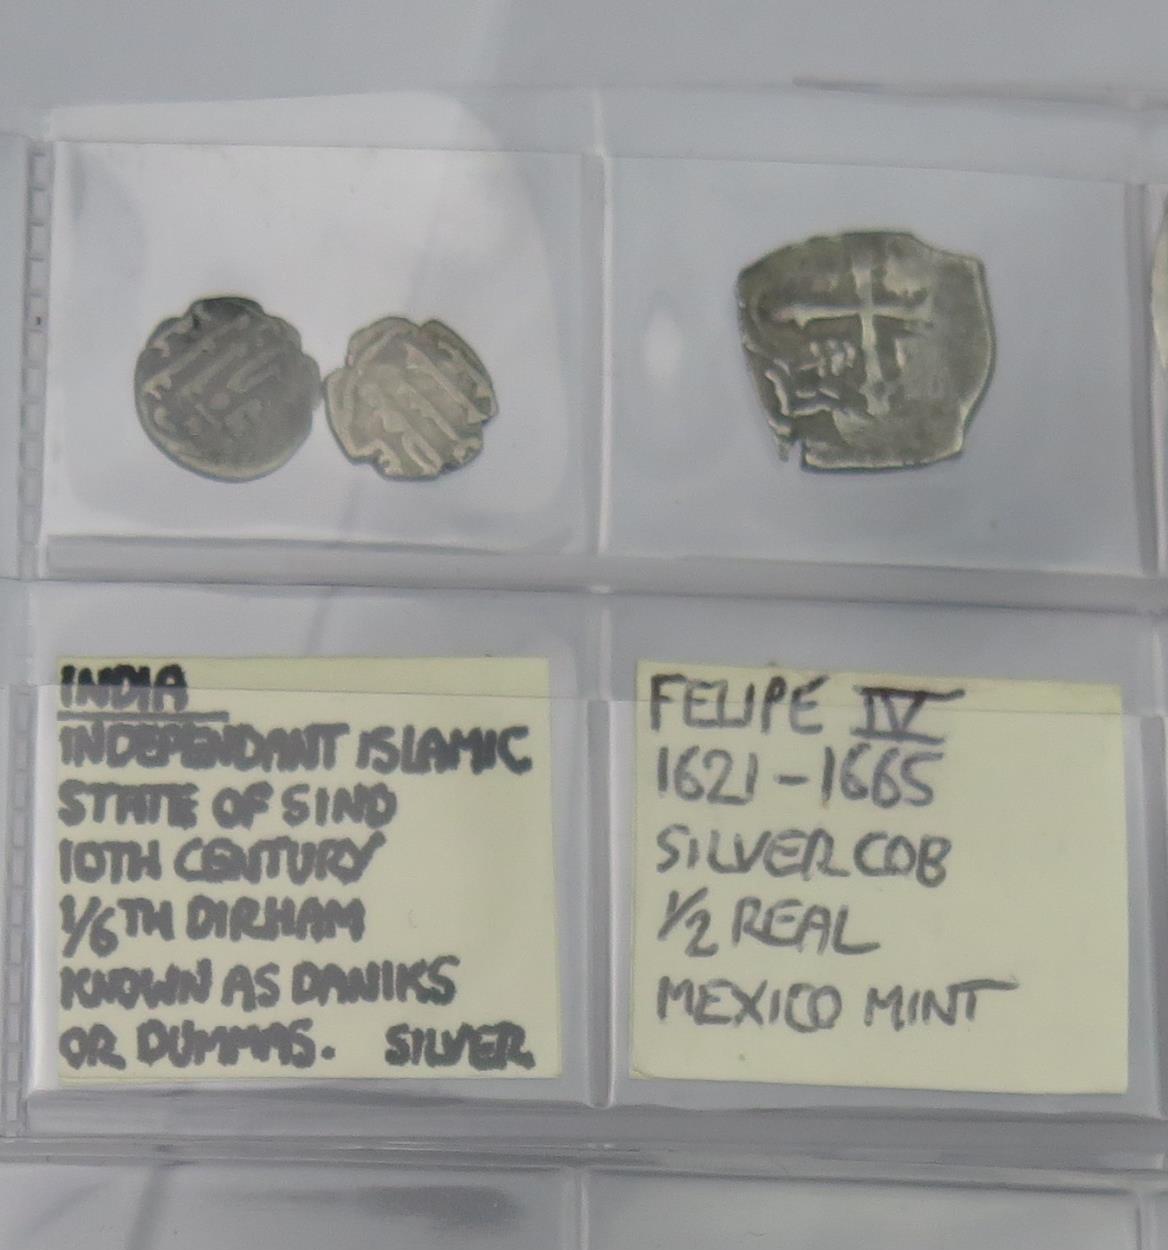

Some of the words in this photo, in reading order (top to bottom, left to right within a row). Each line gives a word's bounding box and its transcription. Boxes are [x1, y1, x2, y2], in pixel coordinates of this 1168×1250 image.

[61, 664, 188, 710] INDIA
[650, 674, 829, 733] FELIPE
[849, 684, 965, 745] IV
[60, 723, 349, 771] INDEPENDANT
[357, 724, 533, 774] ISLAMIC
[58, 780, 200, 828] STATE
[212, 781, 273, 828] OF
[60, 839, 162, 884] 10TH
[174, 830, 386, 885] CENTURY
[656, 824, 850, 881] SILVER
[853, 831, 952, 888] COB
[61, 895, 174, 957] 1/6TH
[187, 896, 366, 941] DIRHAM
[657, 887, 719, 958] 1/2
[732, 897, 881, 955] REAL
[61, 959, 212, 1009] KNOWN
[222, 963, 280, 1011] AS
[293, 955, 459, 1006] DANIKS
[657, 976, 842, 1034] MEXICO
[863, 975, 1019, 1031] MINT
[59, 1023, 126, 1069] OR
[384, 1021, 535, 1069] SILVER
